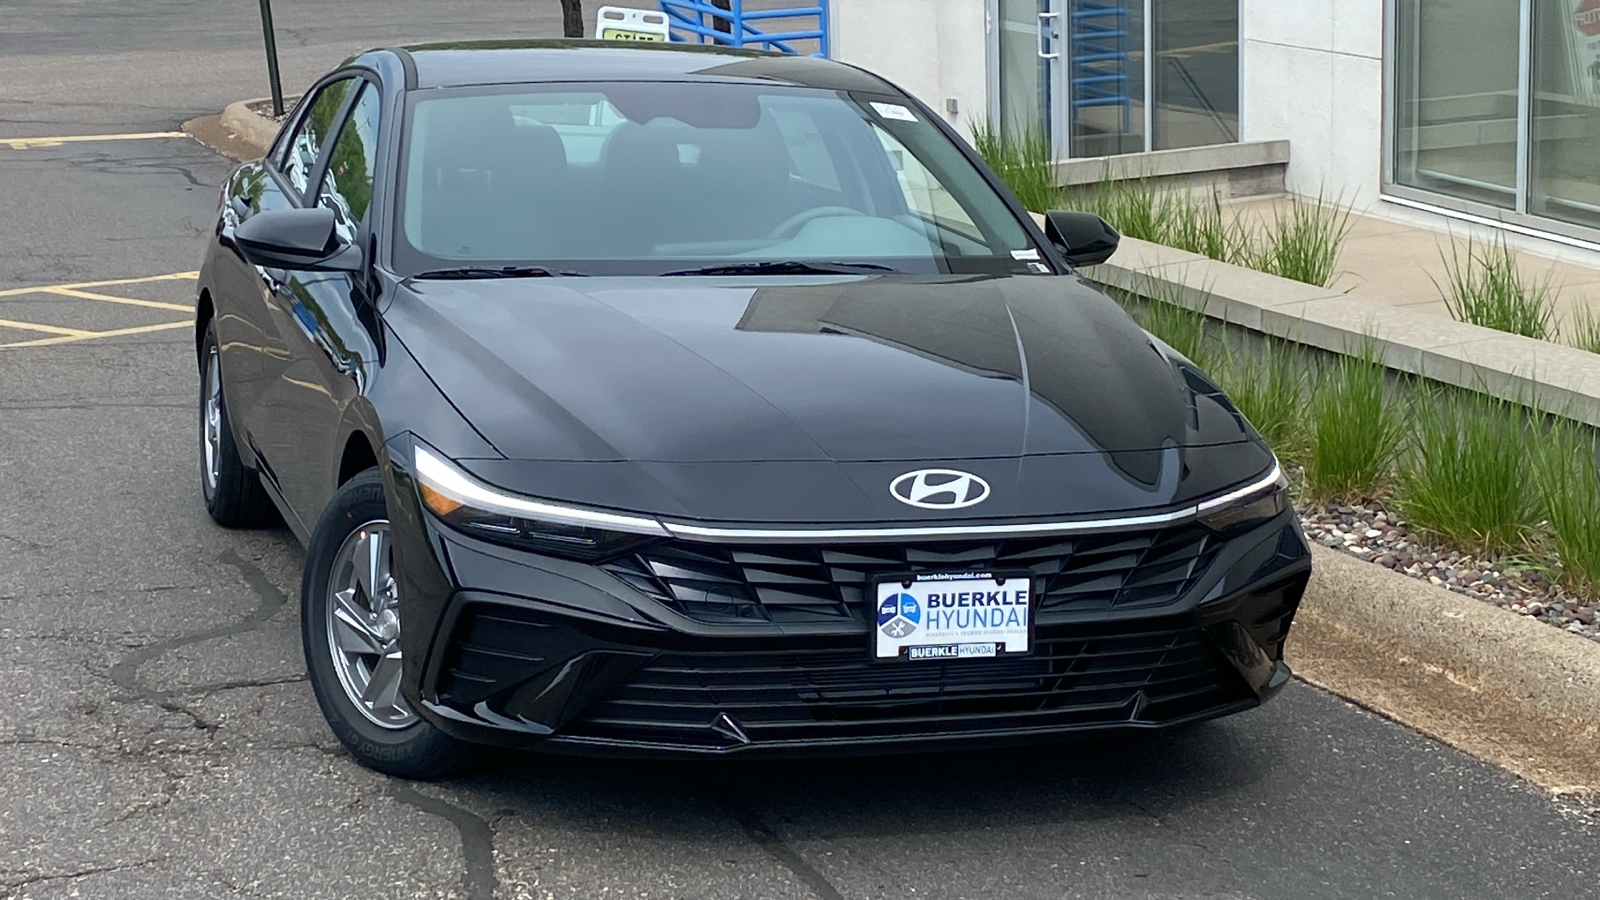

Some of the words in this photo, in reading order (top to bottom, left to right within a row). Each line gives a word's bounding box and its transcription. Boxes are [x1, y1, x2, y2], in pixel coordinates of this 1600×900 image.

[917, 572, 992, 581] buerklehyundai.com
[927, 590, 1027, 608] BUERKLE
[926, 607, 1027, 630] HYUNDAI
[911, 646, 958, 658] BUERKLE
[958, 644, 994, 655] HYUNDAI
